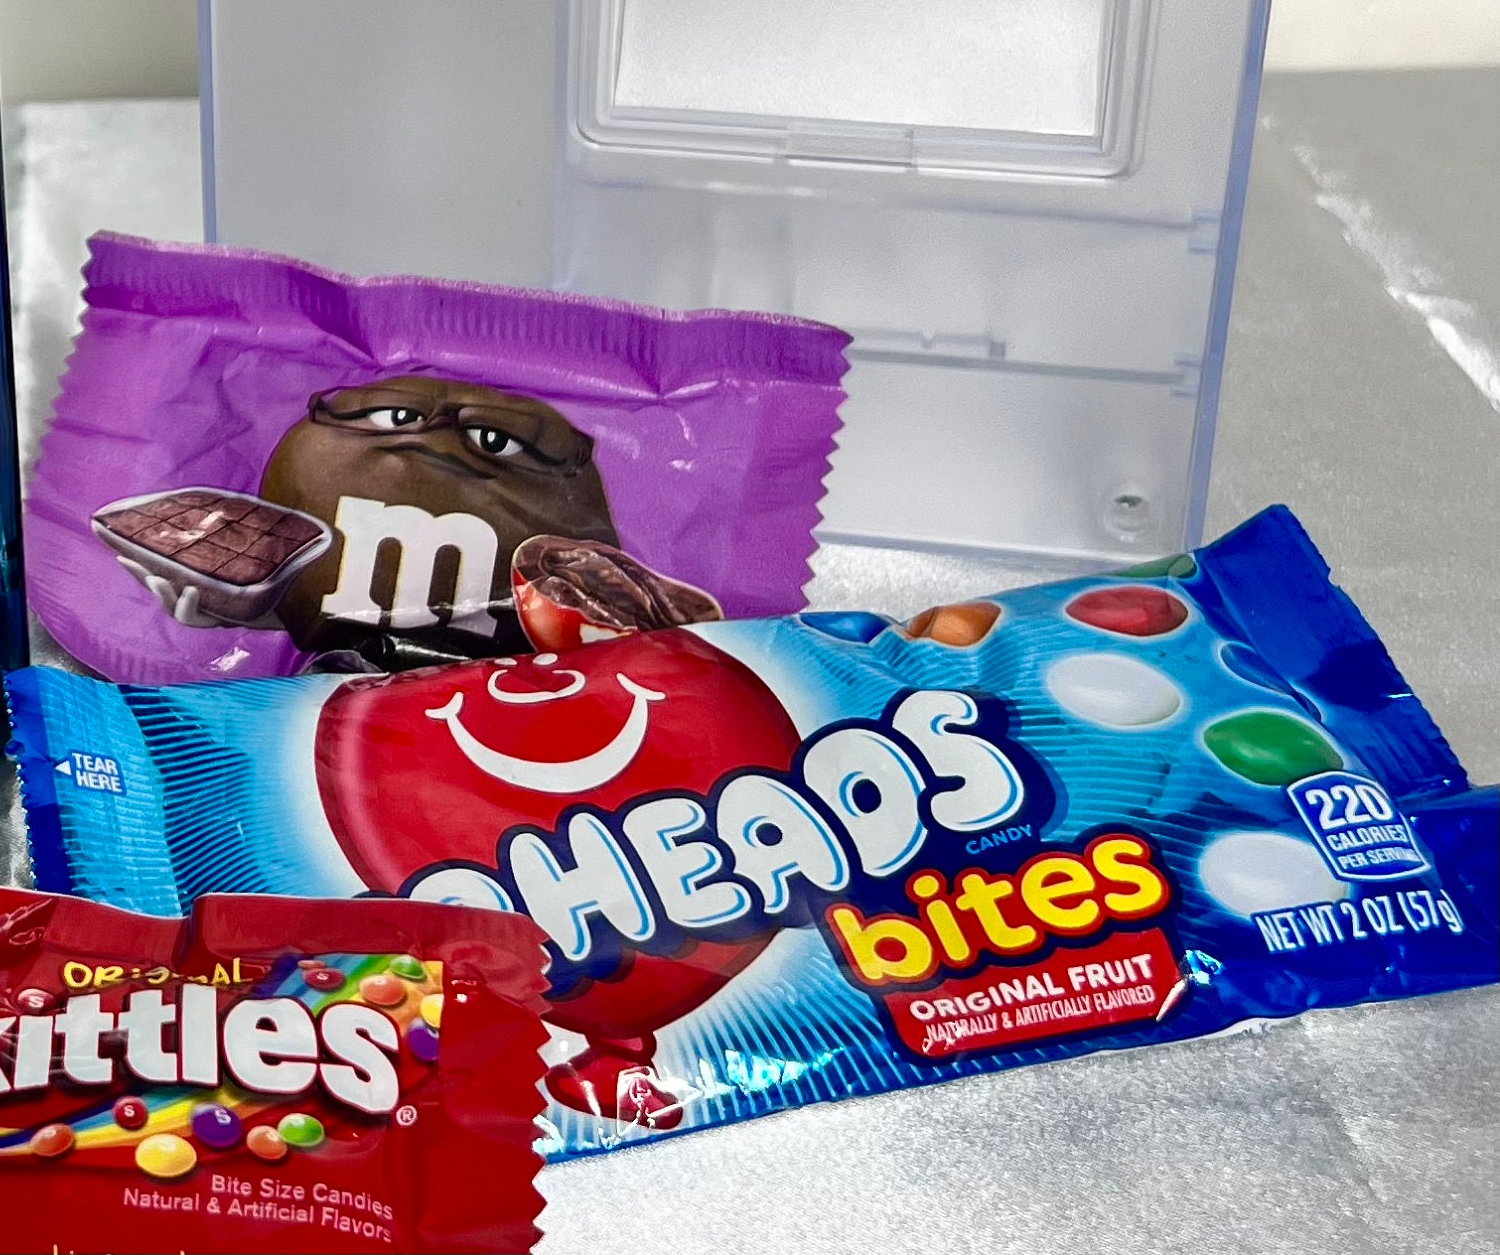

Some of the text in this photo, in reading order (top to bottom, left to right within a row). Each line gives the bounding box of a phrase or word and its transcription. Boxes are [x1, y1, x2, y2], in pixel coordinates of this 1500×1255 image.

[321, 495, 499, 639] m
[72, 751, 119, 776] TEAR
[76, 770, 122, 794] HERE
[408, 690, 1025, 961] HEADS
[1305, 784, 1393, 830] 220
[965, 824, 1033, 855] CANDY
[1326, 824, 1408, 851] CALORIES
[1338, 853, 1368, 870] PER
[832, 838, 1165, 981] bites
[1255, 888, 1463, 953] NET WT 2 OZ (57g)
[909, 954, 1153, 1023] ORIGINAL FRUIT
[925, 984, 1156, 1045] NATURALLY & ARTIFICIALLY FLAVORED
[123, 1186, 393, 1243] Natural & Artificial Flavors
[211, 1174, 394, 1220] Bite Size Candies
